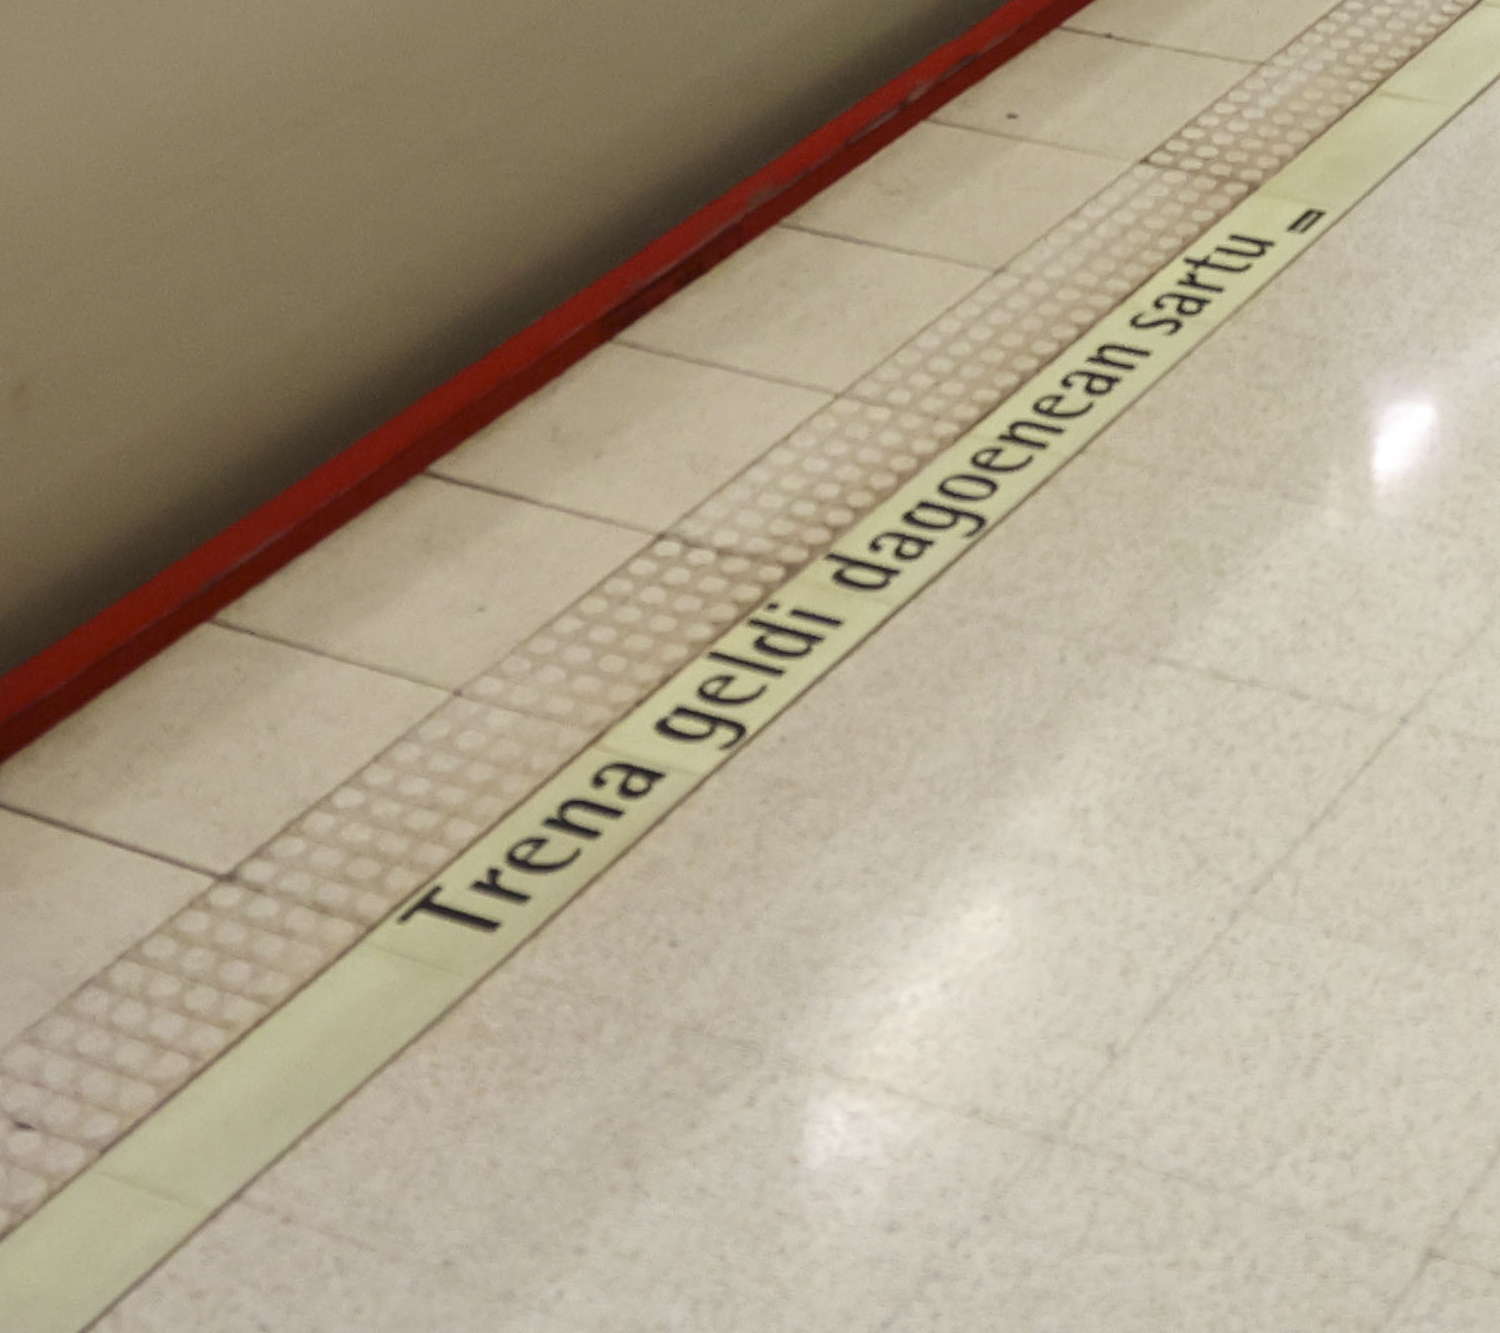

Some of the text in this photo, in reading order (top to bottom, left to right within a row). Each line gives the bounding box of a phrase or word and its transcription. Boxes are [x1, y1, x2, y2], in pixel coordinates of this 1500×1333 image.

[398, 229, 1275, 936] Trena geldi dagoenean sartu
